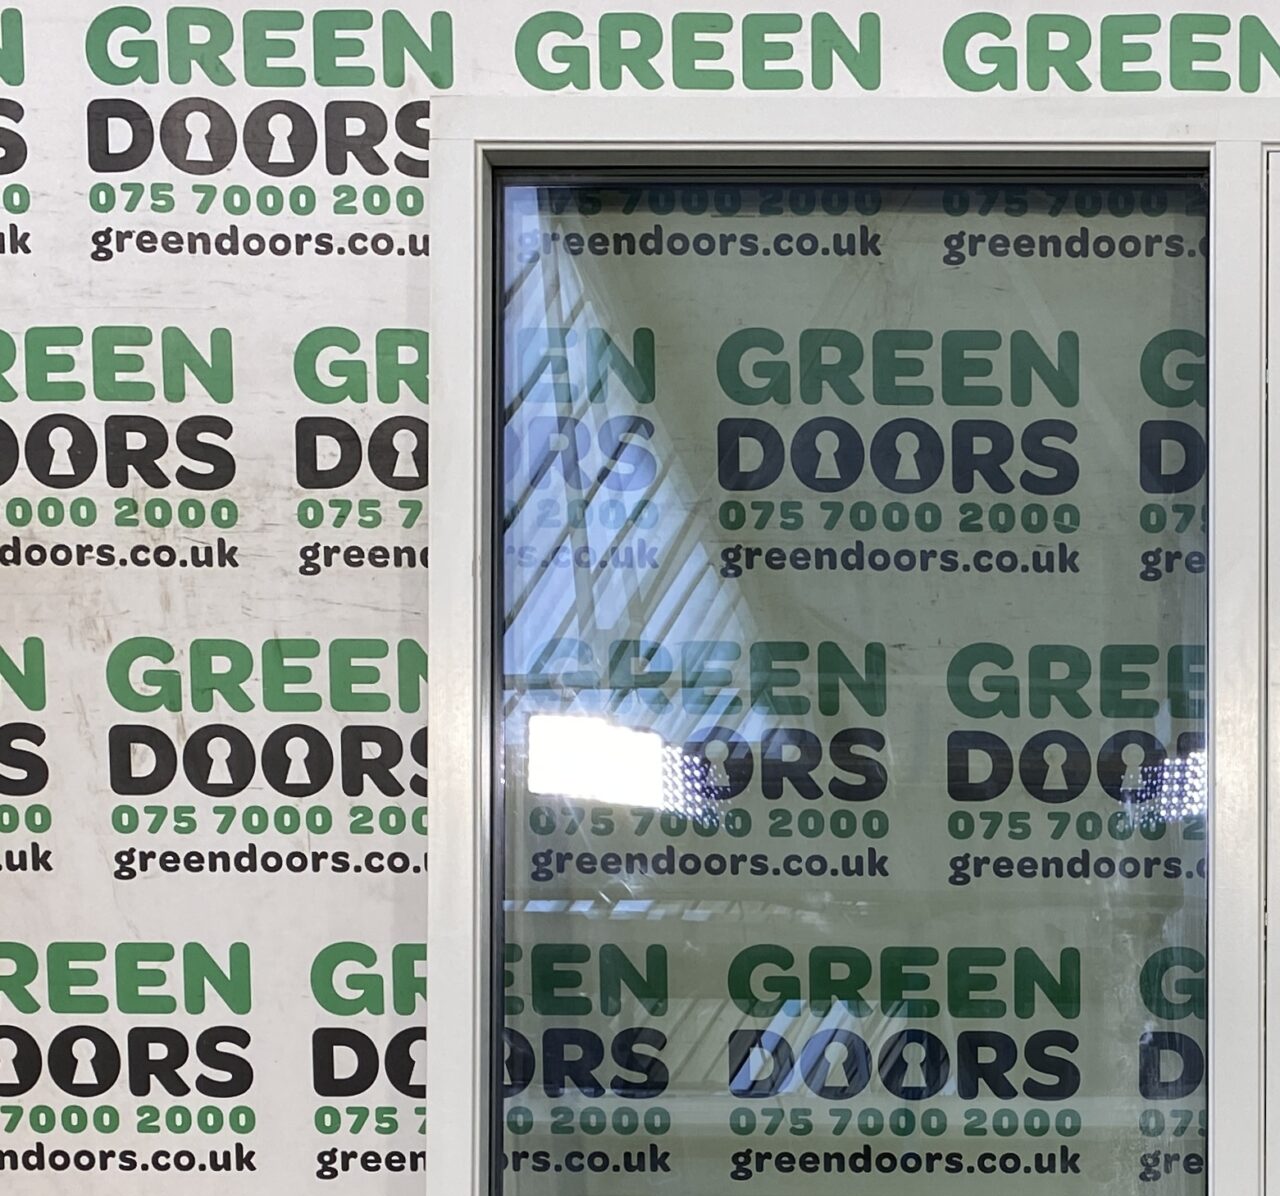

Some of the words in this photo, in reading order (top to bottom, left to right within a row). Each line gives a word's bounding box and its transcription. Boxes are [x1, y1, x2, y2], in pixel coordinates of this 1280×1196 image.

[85, 6, 453, 88] GREEN
[515, 11, 881, 90] GREEN
[89, 183, 175, 213] 075
[192, 184, 316, 216] 7000
[716, 328, 1080, 408] GREEN
[717, 416, 1080, 496] DOORS
[114, 497, 238, 529] 2000
[297, 499, 382, 528] 075
[719, 500, 804, 532] 075
[820, 501, 942, 532] 7000
[959, 502, 1080, 533] 2000
[720, 541, 1080, 580] greendoors.co.uk
[112, 805, 197, 836] 075
[213, 805, 332, 834] 7000
[529, 807, 615, 837] 075
[767, 808, 889, 839] 2000
[948, 810, 1031, 840] 075
[530, 845, 889, 882] greendoors.co.uk
[727, 944, 1081, 1022] GREEN
[728, 1028, 1081, 1101] DOORS
[137, 1105, 255, 1134] 2000
[315, 1106, 398, 1135] 075
[551, 1106, 670, 1135] 2000
[730, 1108, 813, 1136] 075
[829, 1108, 947, 1137] 7000
[964, 1109, 1081, 1137] 2000
[730, 1144, 1081, 1181] greendoors.co.uk
